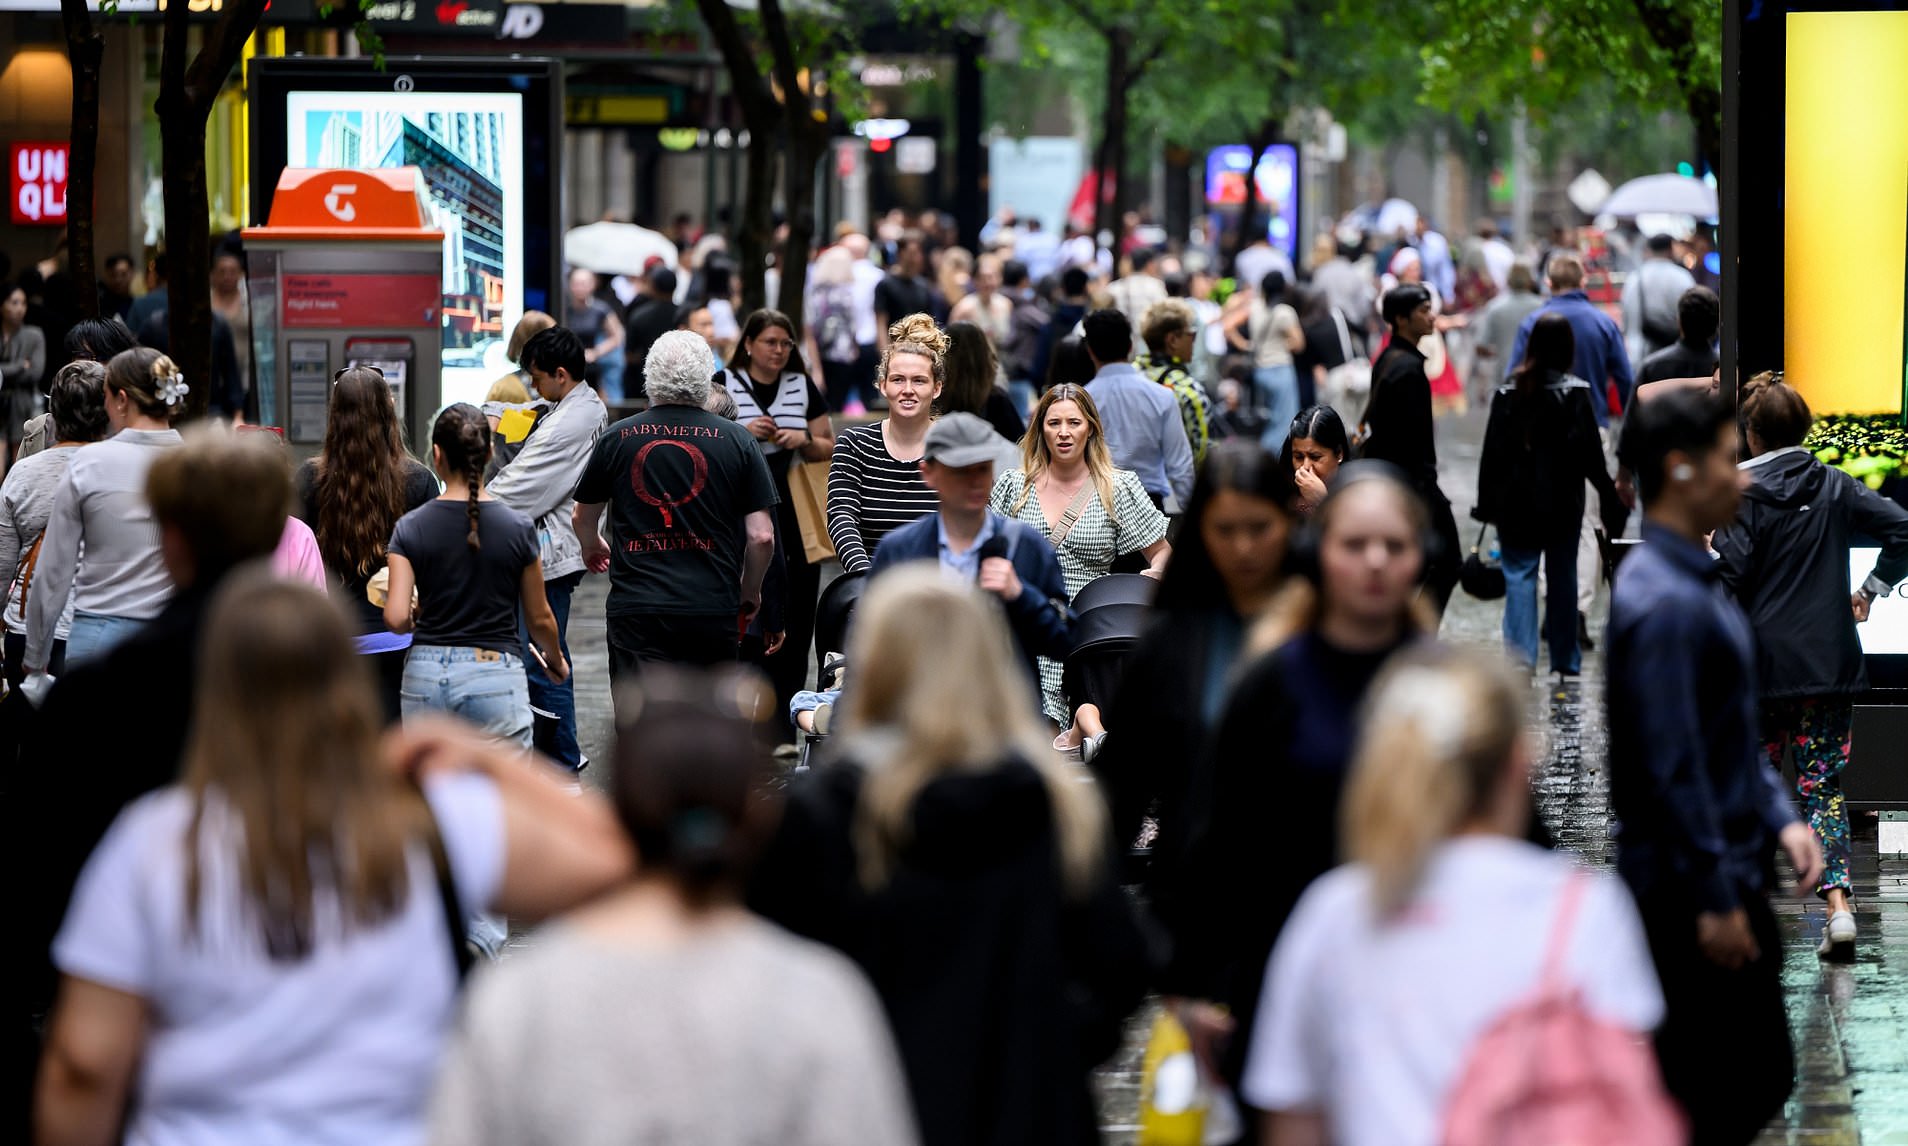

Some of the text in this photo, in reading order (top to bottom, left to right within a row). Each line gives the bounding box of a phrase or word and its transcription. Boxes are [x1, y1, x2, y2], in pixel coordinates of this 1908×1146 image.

[401, 0, 416, 21] 2
[501, 5, 544, 39] JD
[19, 182, 67, 221] QL
[620, 423, 724, 440] BABYMETAL
[623, 538, 715, 552] METALVERSE
